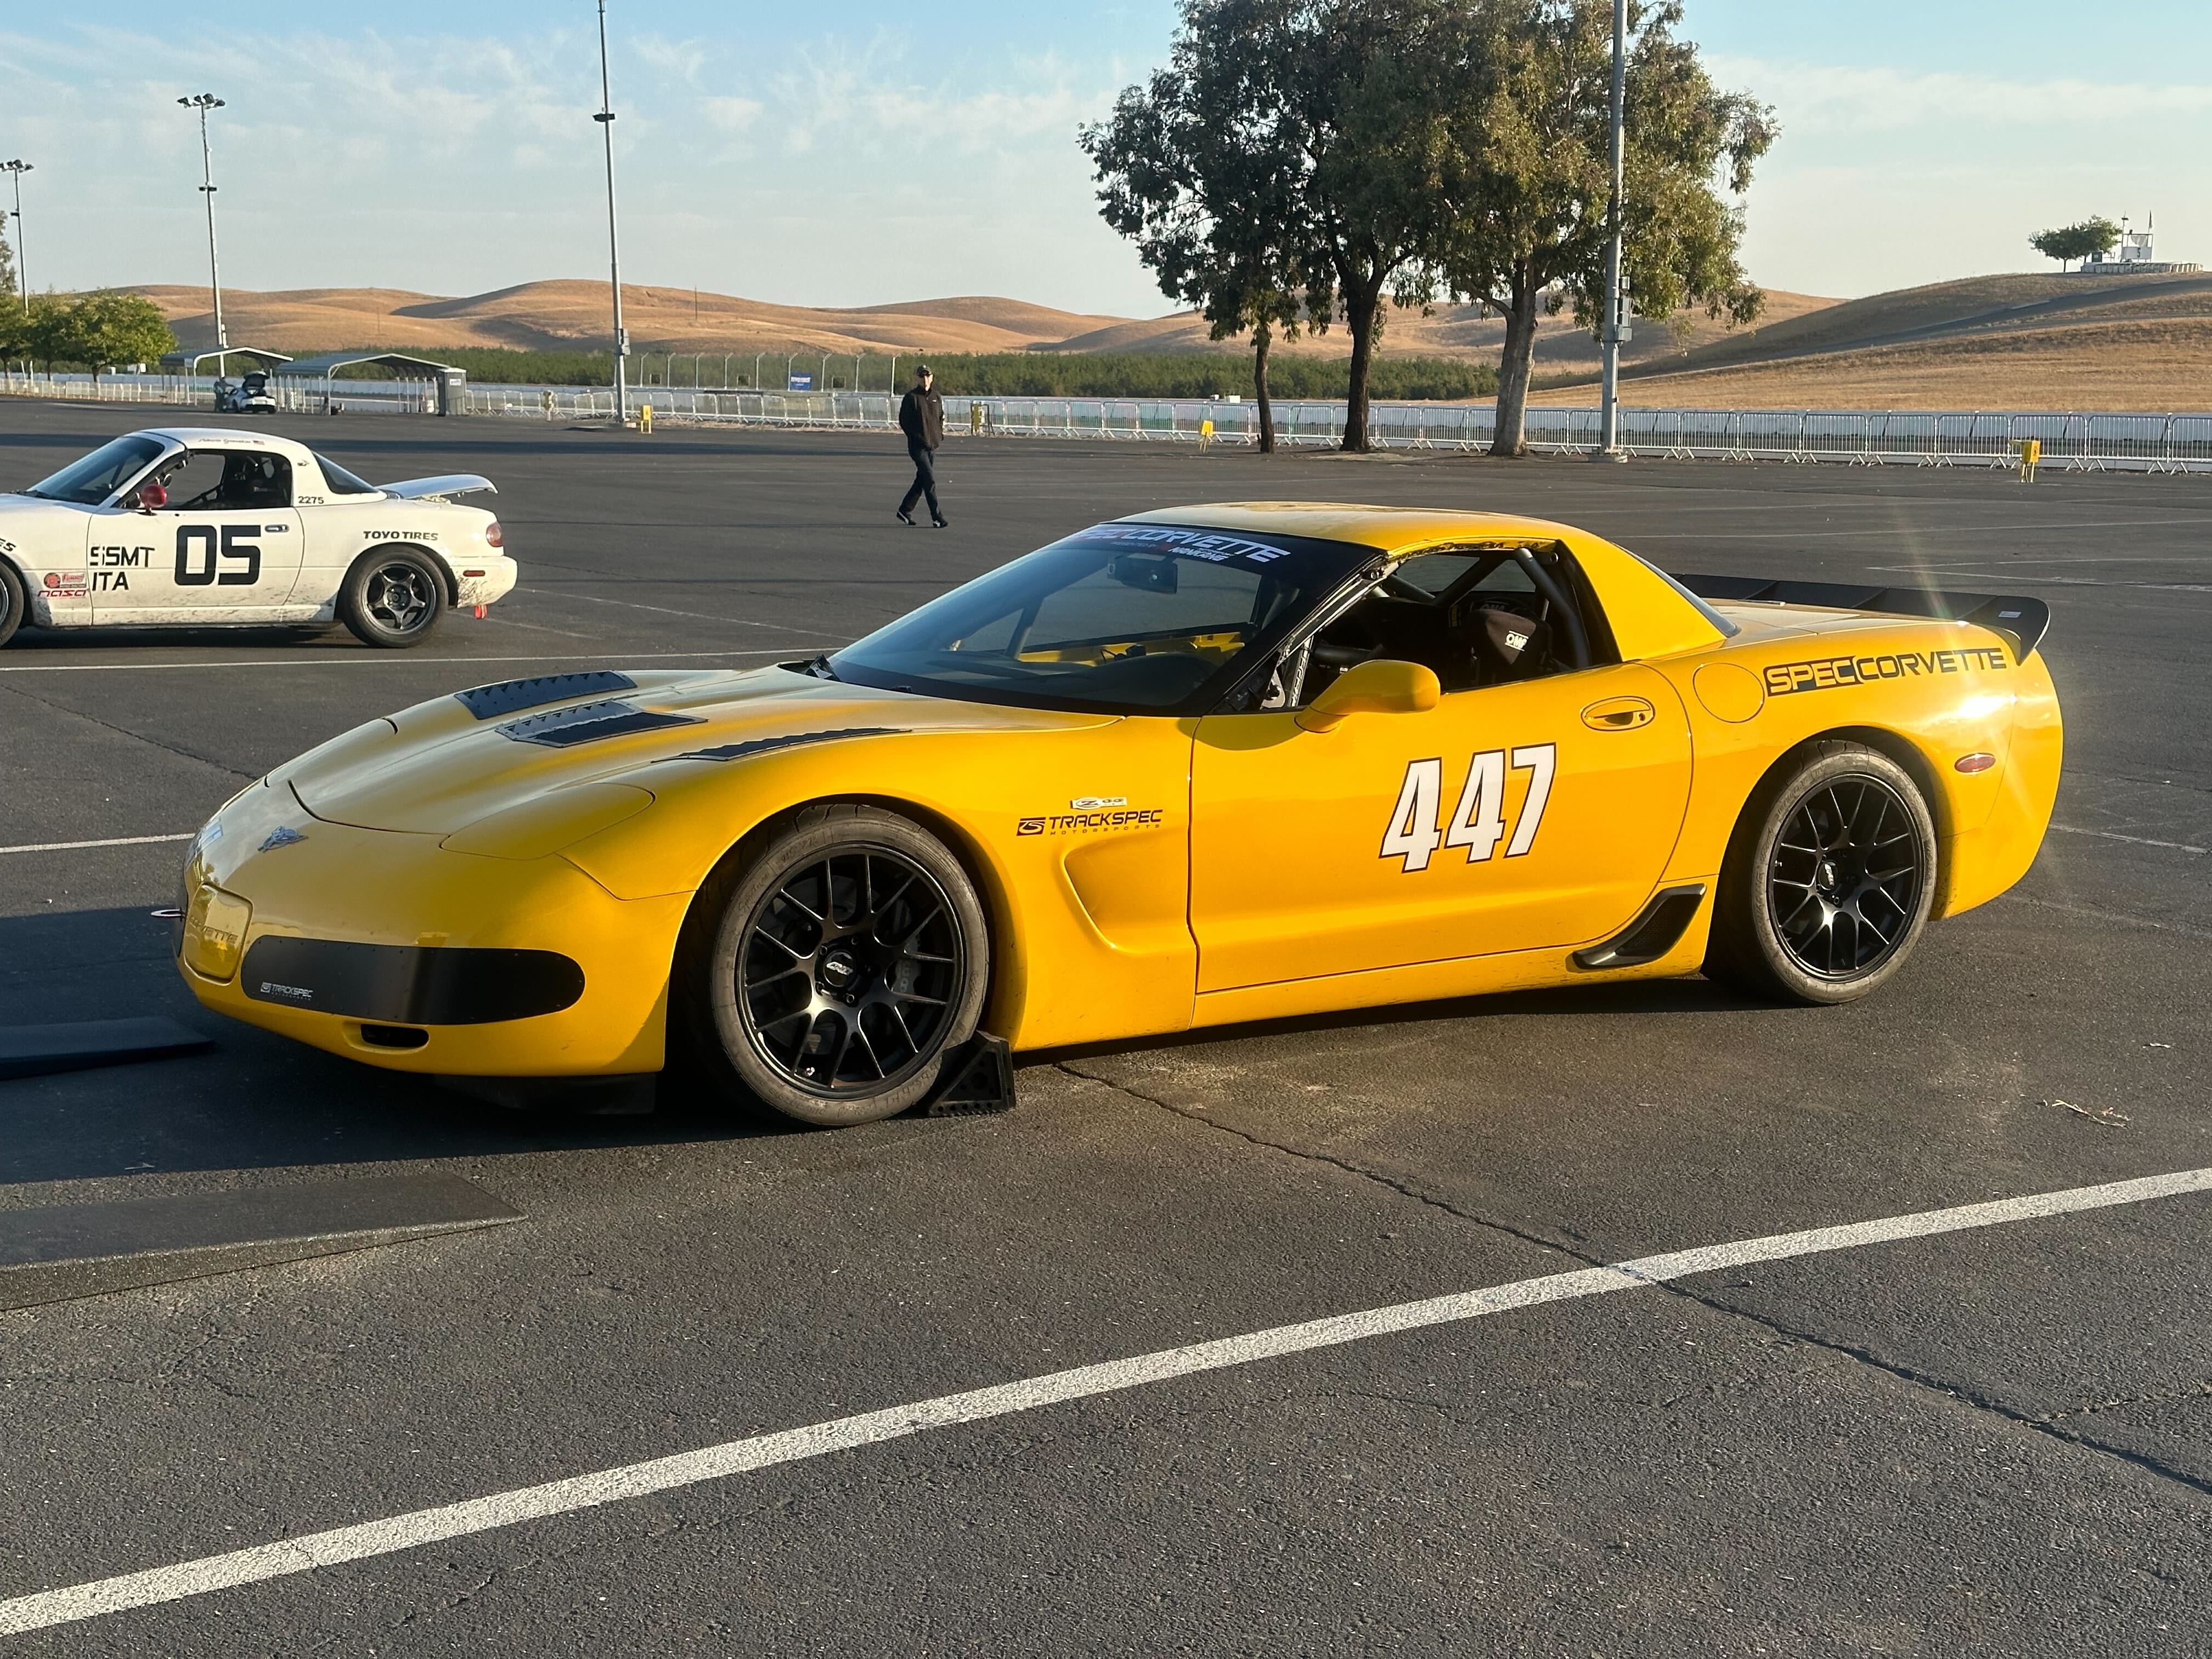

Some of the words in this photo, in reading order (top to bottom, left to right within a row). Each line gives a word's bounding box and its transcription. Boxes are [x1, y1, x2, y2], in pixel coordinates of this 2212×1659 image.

[298, 495, 324, 504] 2275
[363, 531, 400, 539] TOYO
[402, 531, 438, 541] TIRES
[174, 524, 261, 585] 05
[92, 572, 129, 591] ITA
[1505, 633, 1528, 650] OMP
[1378, 742, 1556, 874] 447
[1049, 810, 1163, 829] TRACKSPEC
[1050, 823, 1160, 836] MOTORSPORTS
[272, 984, 313, 998] TRACKSPEC
